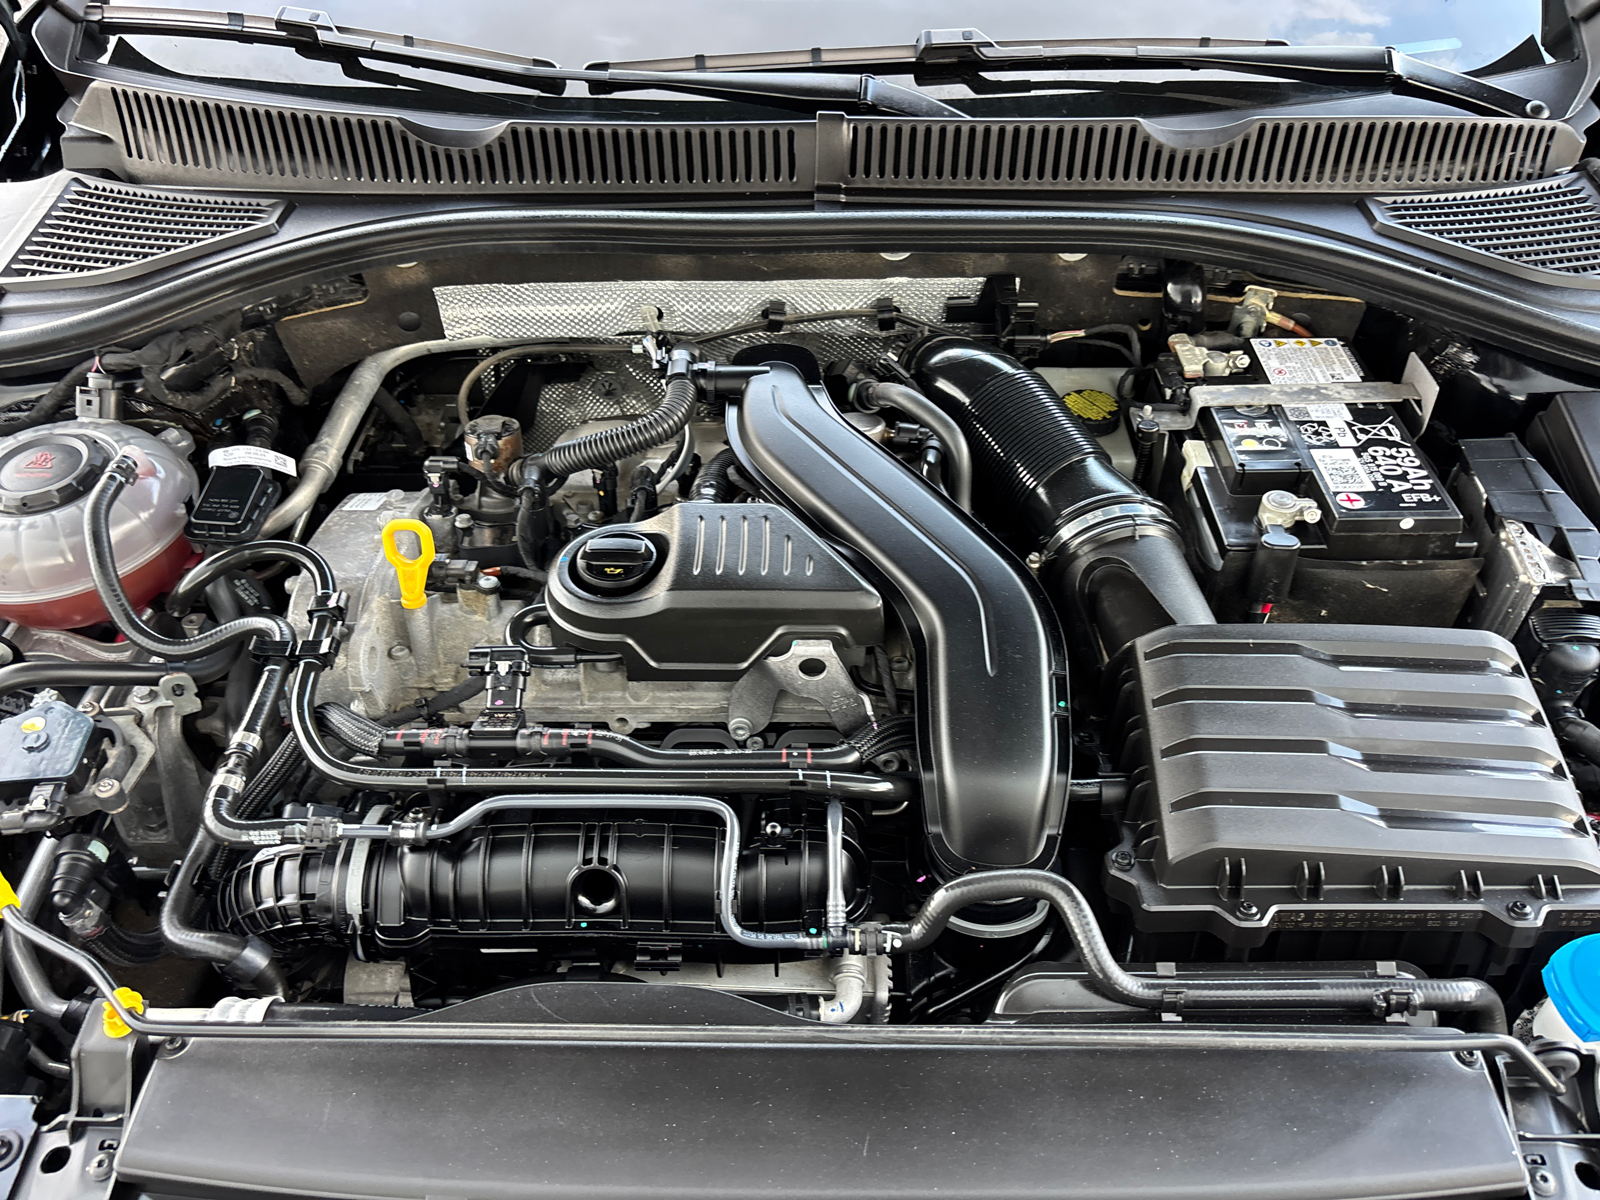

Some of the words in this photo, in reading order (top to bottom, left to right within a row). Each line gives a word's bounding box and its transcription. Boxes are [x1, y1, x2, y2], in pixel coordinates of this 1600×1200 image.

[1334, 427, 1347, 437] Pb
[1367, 446, 1403, 475] 640
[1385, 479, 1413, 492] A
[1390, 447, 1434, 490] 59Ah
